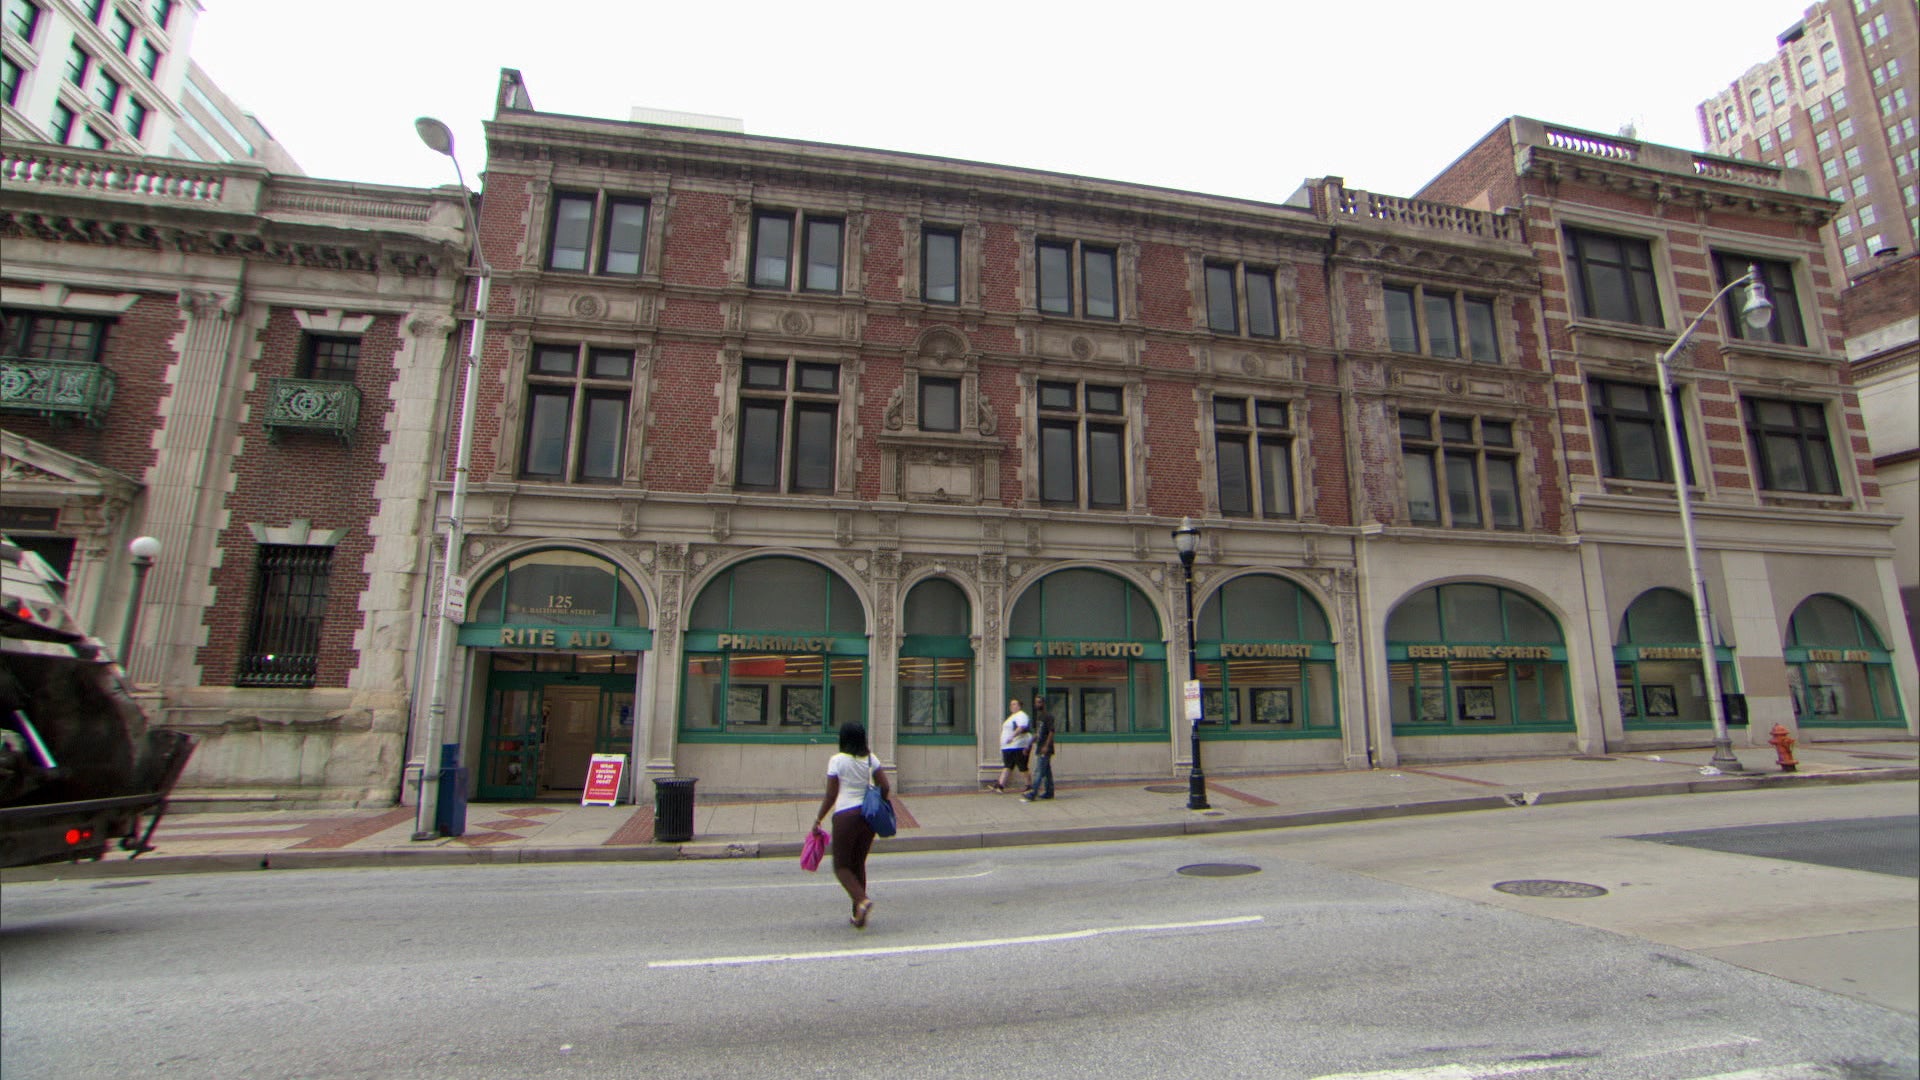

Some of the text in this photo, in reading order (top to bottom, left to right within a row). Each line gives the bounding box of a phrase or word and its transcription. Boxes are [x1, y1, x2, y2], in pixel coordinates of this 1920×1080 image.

[548, 594, 573, 609] 125
[500, 627, 612, 648] RITE AID
[717, 633, 836, 652] PHARMACY
[1033, 640, 1144, 657] 1 HR PHOTO
[1220, 643, 1312, 658] FOODMART
[1638, 647, 1703, 659] PHARMAC
